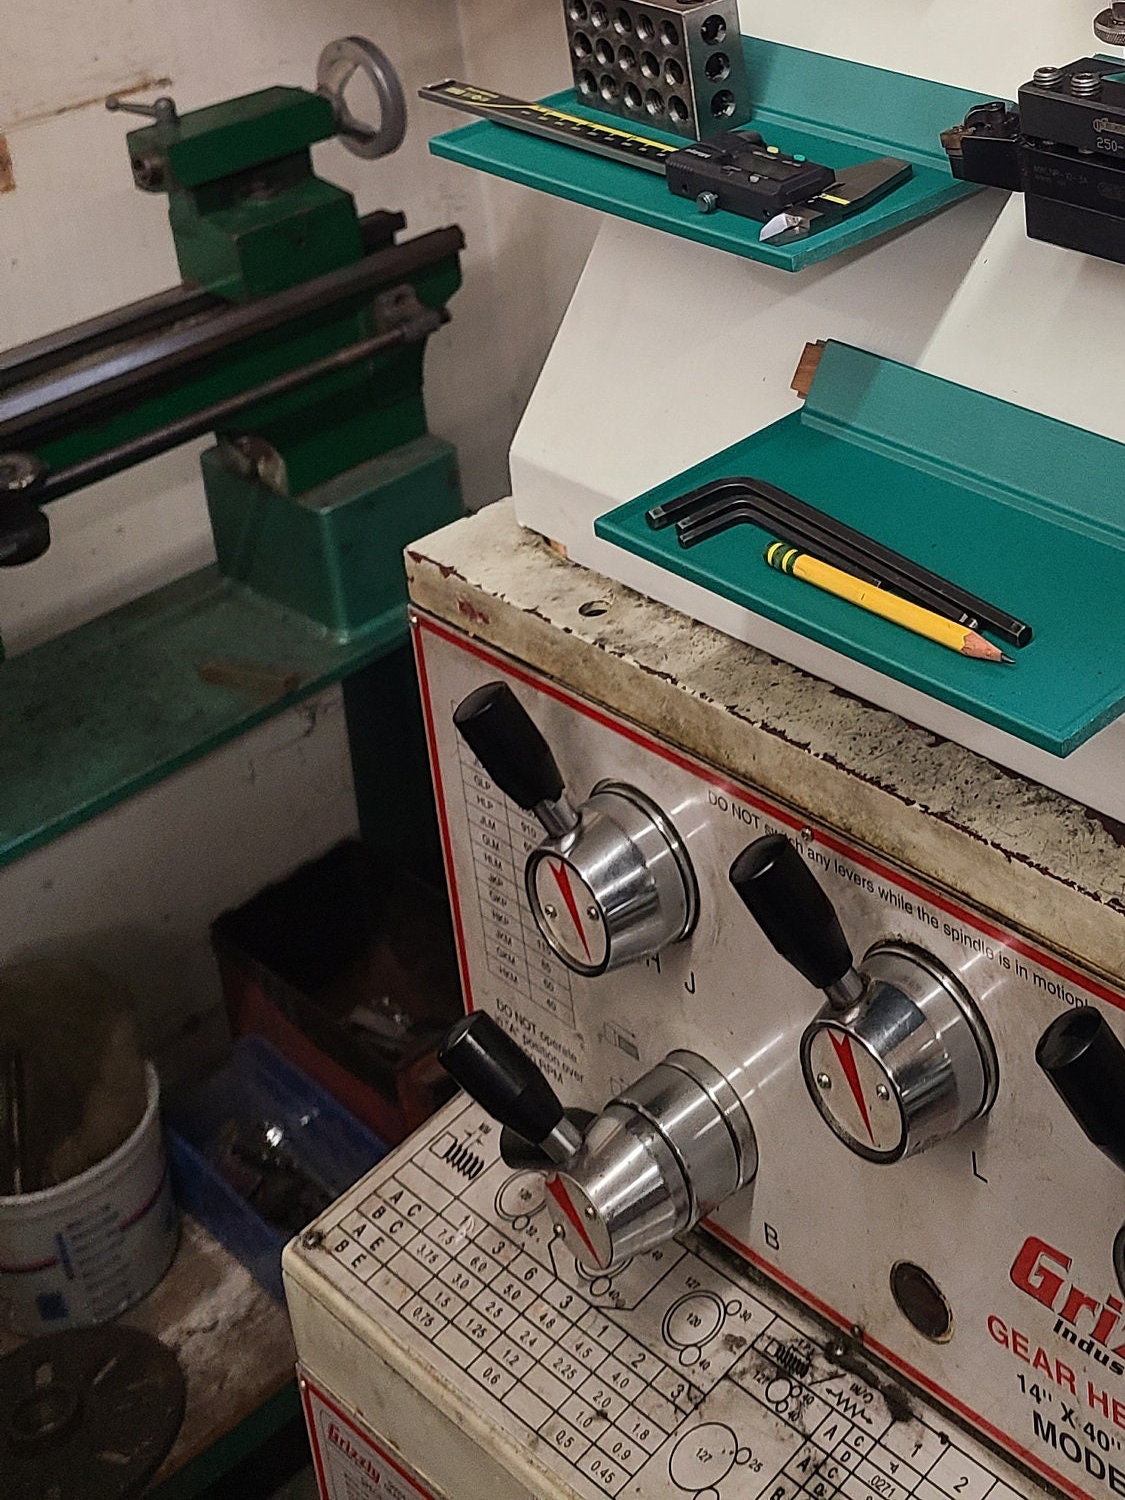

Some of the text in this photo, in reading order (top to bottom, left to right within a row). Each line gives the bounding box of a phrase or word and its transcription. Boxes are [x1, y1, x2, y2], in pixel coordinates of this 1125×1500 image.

[708, 790, 1029, 980] DO NOT any levers while the spindle is in
[684, 971, 696, 994] J
[390, 1190, 422, 1217] A C
[389, 1221, 404, 1234] C
[764, 1221, 780, 1251] B
[353, 1223, 385, 1252] A E
[492, 1241, 505, 1255] 3
[351, 1253, 366, 1269] E
[524, 1267, 538, 1281] 6
[503, 1284, 521, 1301] 5.0
[485, 1301, 504, 1318] 2.5
[560, 1295, 573, 1310] 3
[412, 1306, 435, 1328] 0.75
[465, 1317, 487, 1339] 1.25
[519, 1330, 538, 1347] 2.4
[502, 1349, 520, 1367] 1.2
[574, 1341, 593, 1359] 4.5
[987, 1314, 1077, 1396] GEAR
[552, 1357, 578, 1380] 2.25
[631, 1353, 646, 1368] 2
[482, 1367, 501, 1385] 0.6
[611, 1371, 630, 1388] 4.0
[592, 1390, 612, 1409] 2.0
[575, 1411, 593, 1428] 1.0
[555, 1429, 575, 1448] 0.5
[631, 1422, 650, 1440] 1.8
[823, 1424, 839, 1441] A
[853, 1436, 865, 1447] C
[327, 1422, 381, 1485] Grizzly
[612, 1442, 632, 1461] 0.9
[840, 1451, 852, 1462] D
[590, 1460, 616, 1484] 0.45
[748, 1459, 764, 1474] 25
[827, 1467, 839, 1479] C
[867, 1474, 897, 1499] .0271
[952, 1476, 969, 1494] 2
